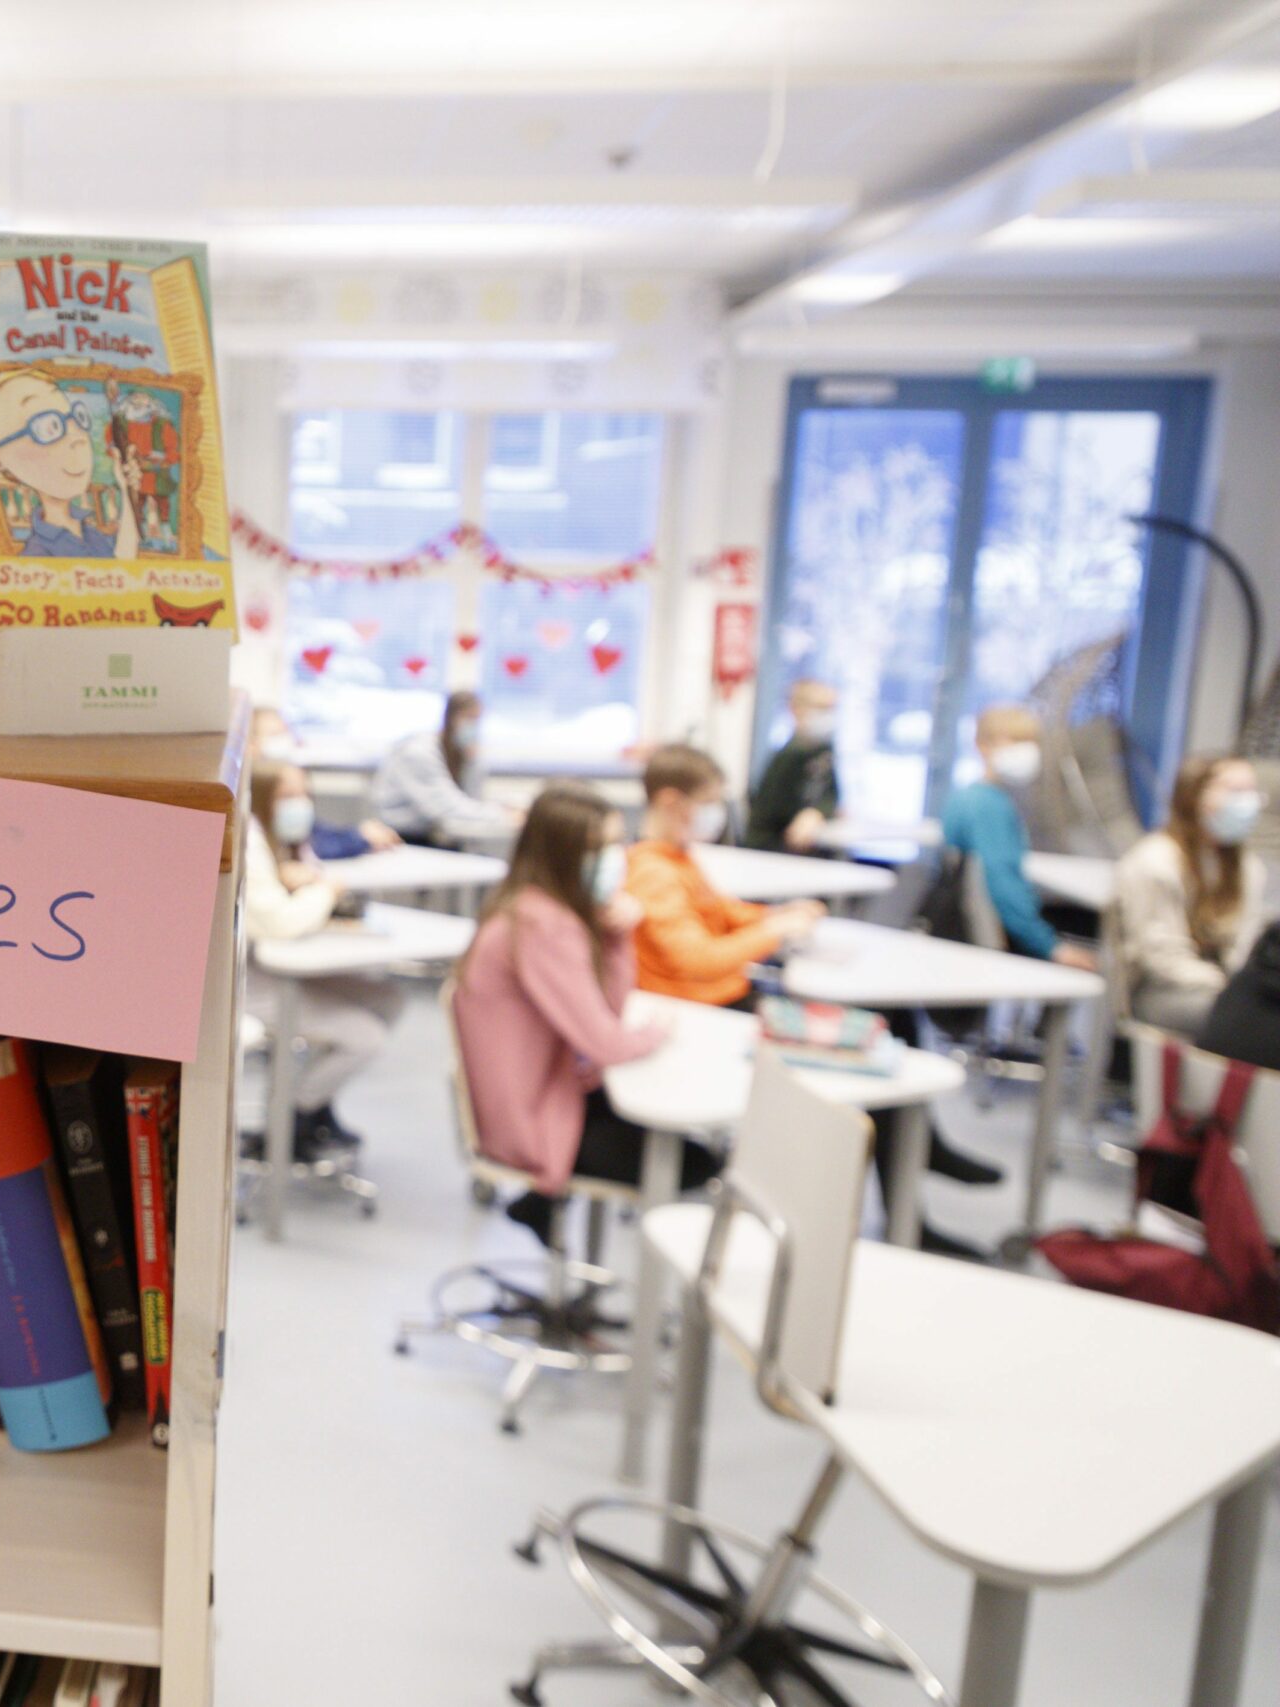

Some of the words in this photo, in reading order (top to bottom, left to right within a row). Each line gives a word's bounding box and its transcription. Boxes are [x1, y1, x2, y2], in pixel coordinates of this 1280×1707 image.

[16, 253, 133, 314] Nick
[56, 310, 78, 322] and
[80, 310, 99, 322] the
[6, 325, 67, 353] Canal
[74, 326, 153, 359] Painter
[74, 570, 124, 590] Facts
[81, 685, 158, 698] TAMMI
